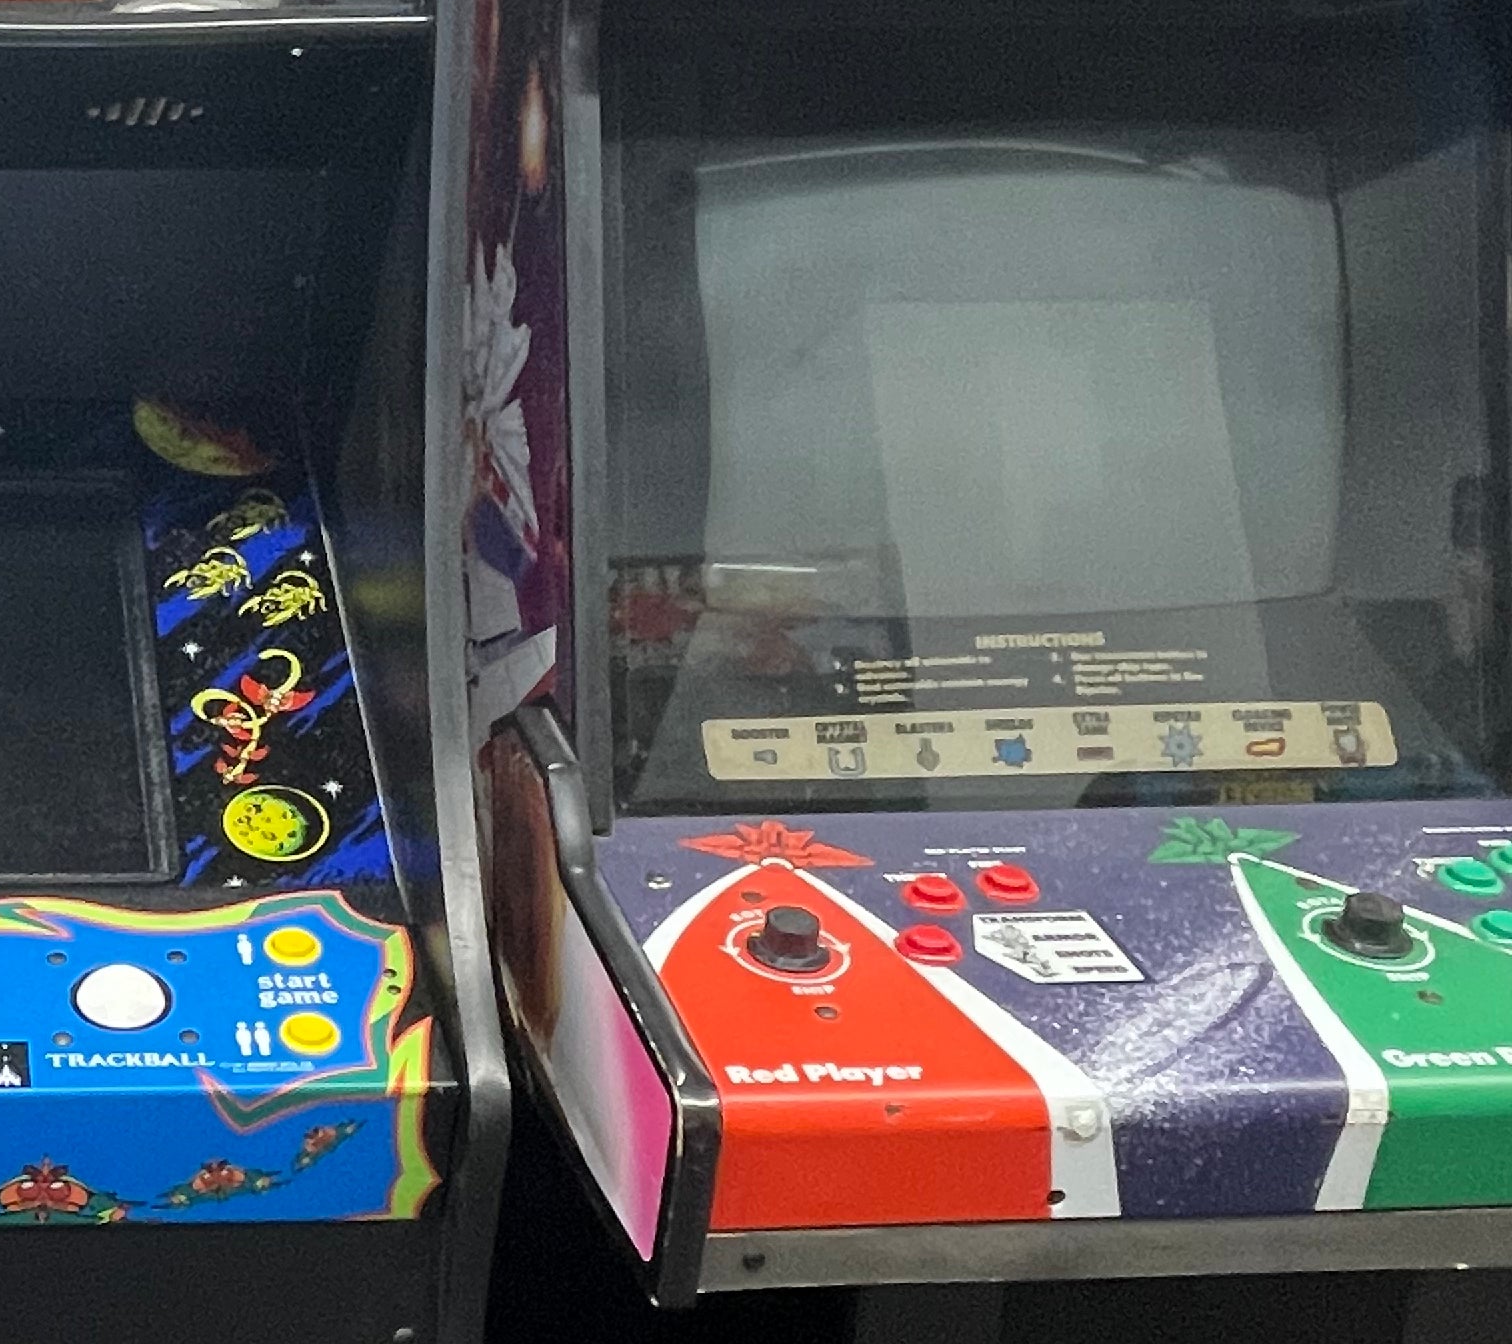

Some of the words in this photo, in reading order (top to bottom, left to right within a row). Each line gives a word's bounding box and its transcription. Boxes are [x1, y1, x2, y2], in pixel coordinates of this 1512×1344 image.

[974, 631, 1106, 650] INSTRUCTIONS
[257, 972, 332, 990] start
[258, 990, 339, 1008] game
[44, 1050, 216, 1068] TRACKBALL
[1381, 1047, 1498, 1068] Green
[724, 1062, 800, 1085] Red
[801, 1062, 924, 1087] Player
